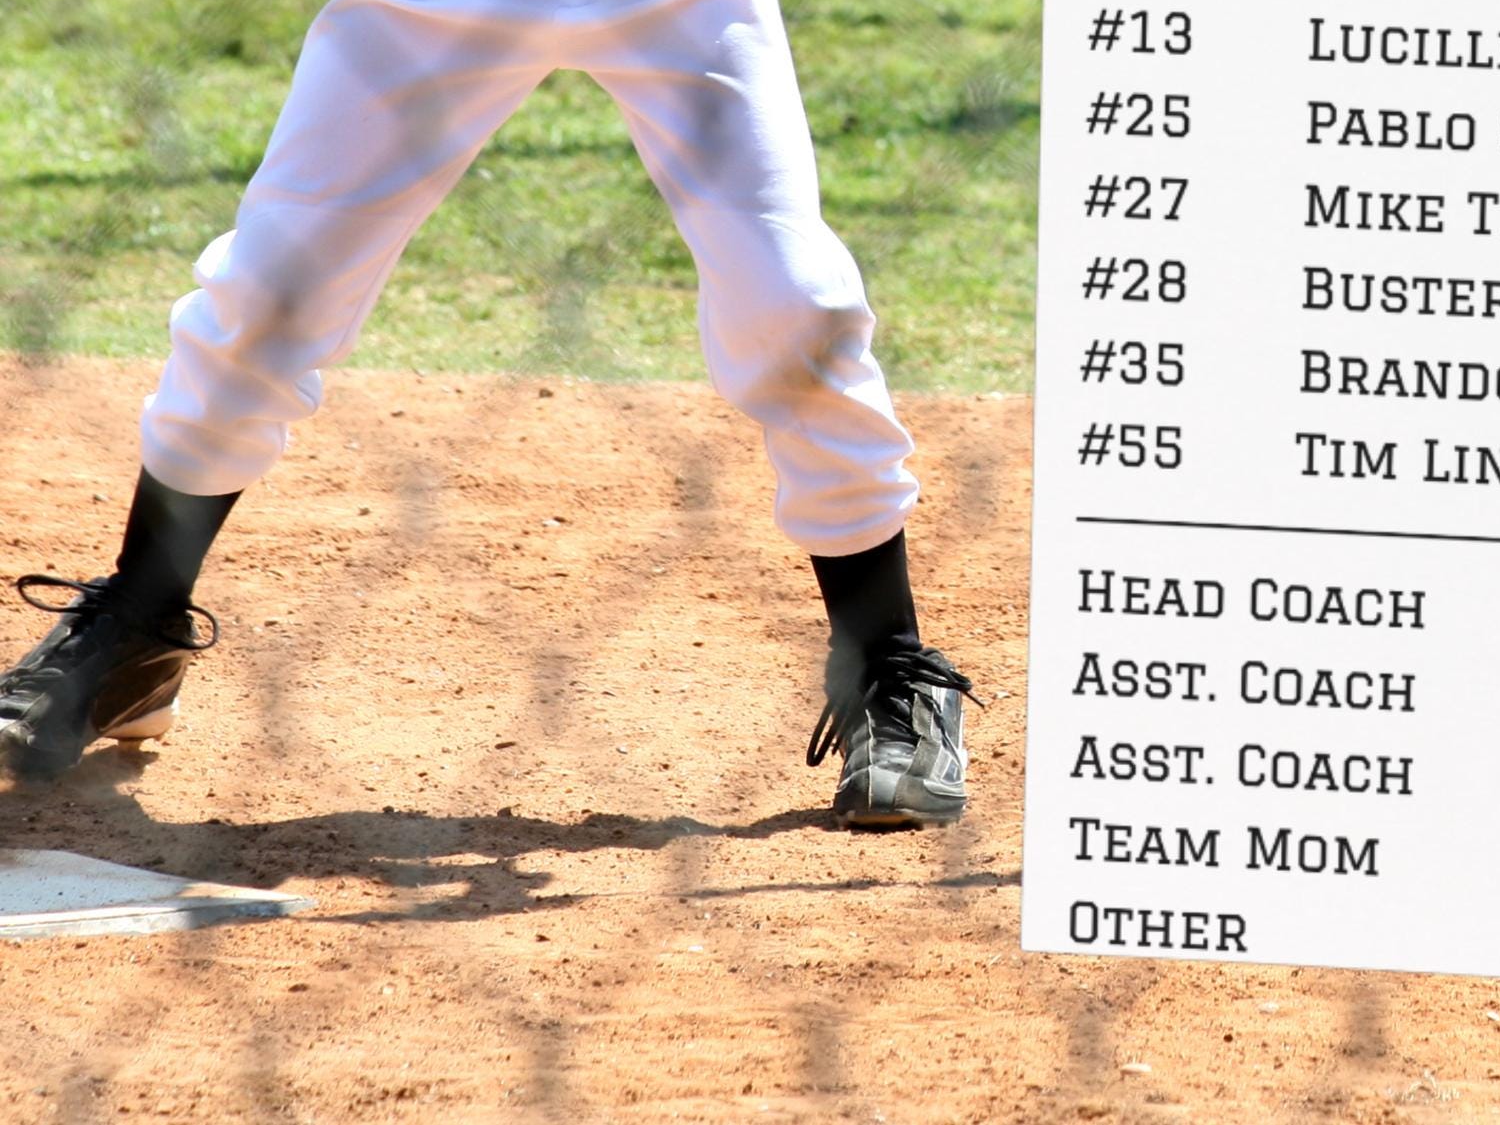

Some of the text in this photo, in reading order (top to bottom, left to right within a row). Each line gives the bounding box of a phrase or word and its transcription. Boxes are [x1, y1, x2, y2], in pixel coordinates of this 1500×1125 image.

[1088, 8, 1192, 55] #13
[1086, 91, 1190, 138] #25
[1306, 100, 1476, 151] PABLO
[1084, 174, 1189, 221] #27
[1304, 184, 1445, 233] MIKE
[1082, 256, 1186, 303] #28
[1079, 339, 1184, 387] #35
[1077, 422, 1182, 470] #55
[1295, 432, 1398, 480] TIM
[1078, 569, 1225, 619] HEAD
[1250, 578, 1426, 629] COACH
[1072, 652, 1216, 702] ASST.
[1240, 660, 1416, 713] COACH
[1069, 735, 1213, 785] ASST.
[1238, 743, 1414, 796] COACH
[1069, 817, 1221, 868] TEAM
[1246, 826, 1380, 876] MOM
[1069, 900, 1248, 953] OTHER
